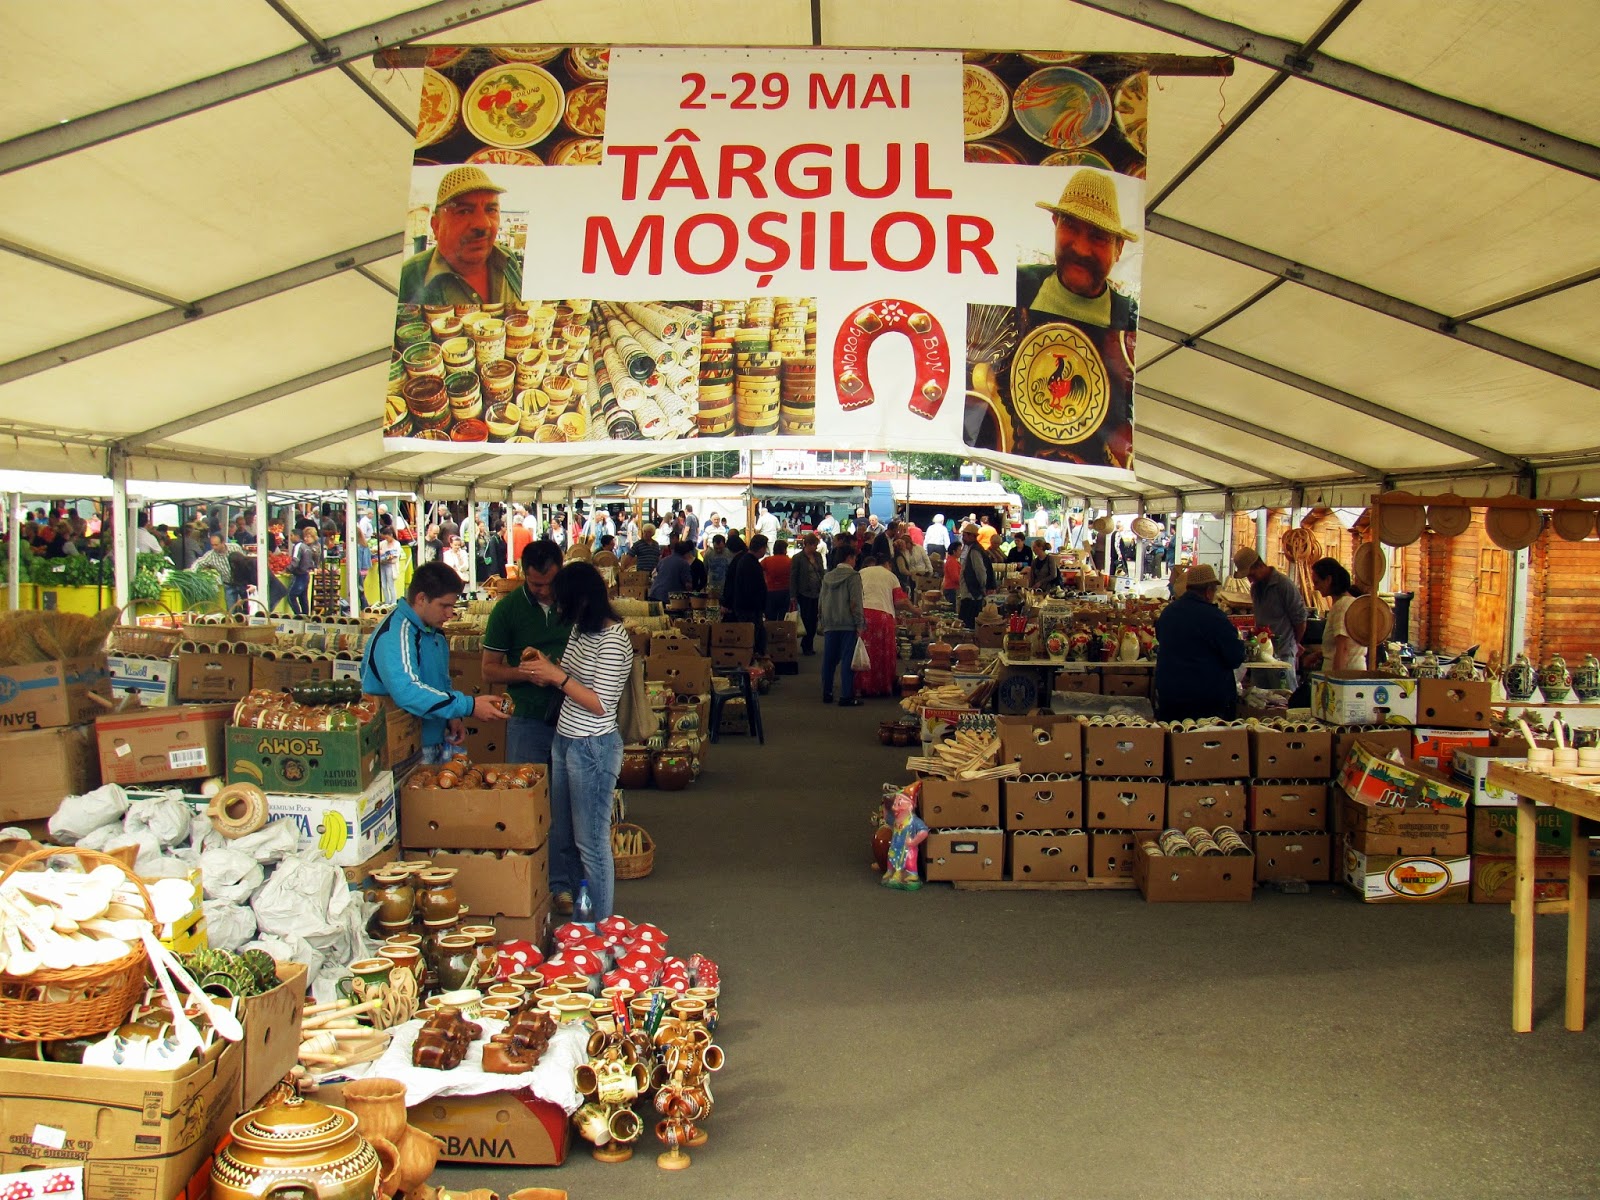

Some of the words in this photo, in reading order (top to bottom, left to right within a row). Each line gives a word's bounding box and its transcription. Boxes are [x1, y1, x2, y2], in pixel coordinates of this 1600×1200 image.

[679, 72, 790, 110] 2-29
[808, 73, 911, 110] MAI
[606, 128, 953, 201] TÂRGUL
[922, 335, 945, 373] BUN
[257, 737, 324, 757] TOMY
[323, 769, 357, 778] QUALITY
[323, 779, 358, 787] PREMIUM
[12, 1145, 42, 1159] Pays
[78, 1141, 93, 1152] de
[432, 1135, 516, 1159] RBANA
[43, 1149, 89, 1162] Banane
